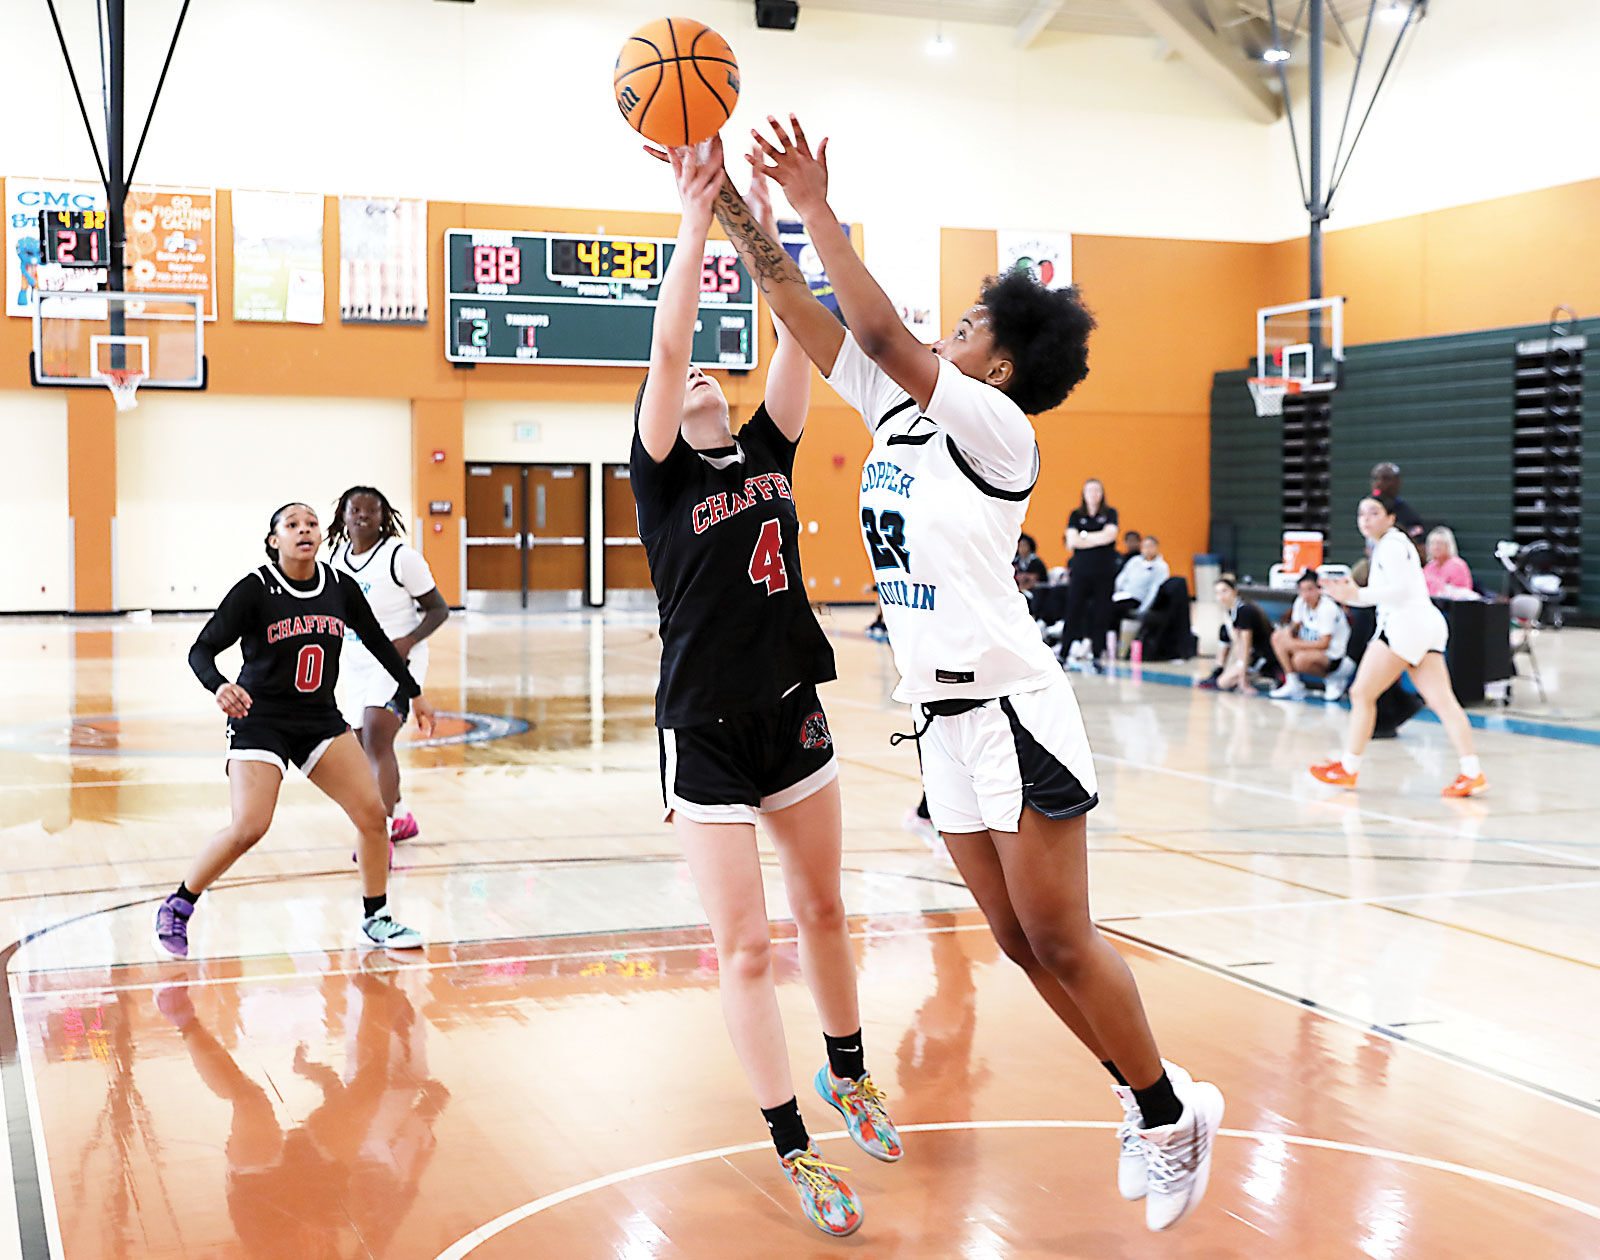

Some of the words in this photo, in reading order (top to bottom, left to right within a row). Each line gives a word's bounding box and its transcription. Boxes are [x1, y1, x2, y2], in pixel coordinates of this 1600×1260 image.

[17, 191, 96, 211] CMC
[56, 230, 99, 263] 21
[473, 245, 522, 285] 88
[577, 240, 656, 279] 4:32
[700, 255, 742, 294] 65
[471, 318, 490, 347] 2
[526, 325, 536, 348] 1
[692, 472, 795, 535] CHAFFE
[747, 517, 789, 597] 4
[294, 643, 325, 693] 0
